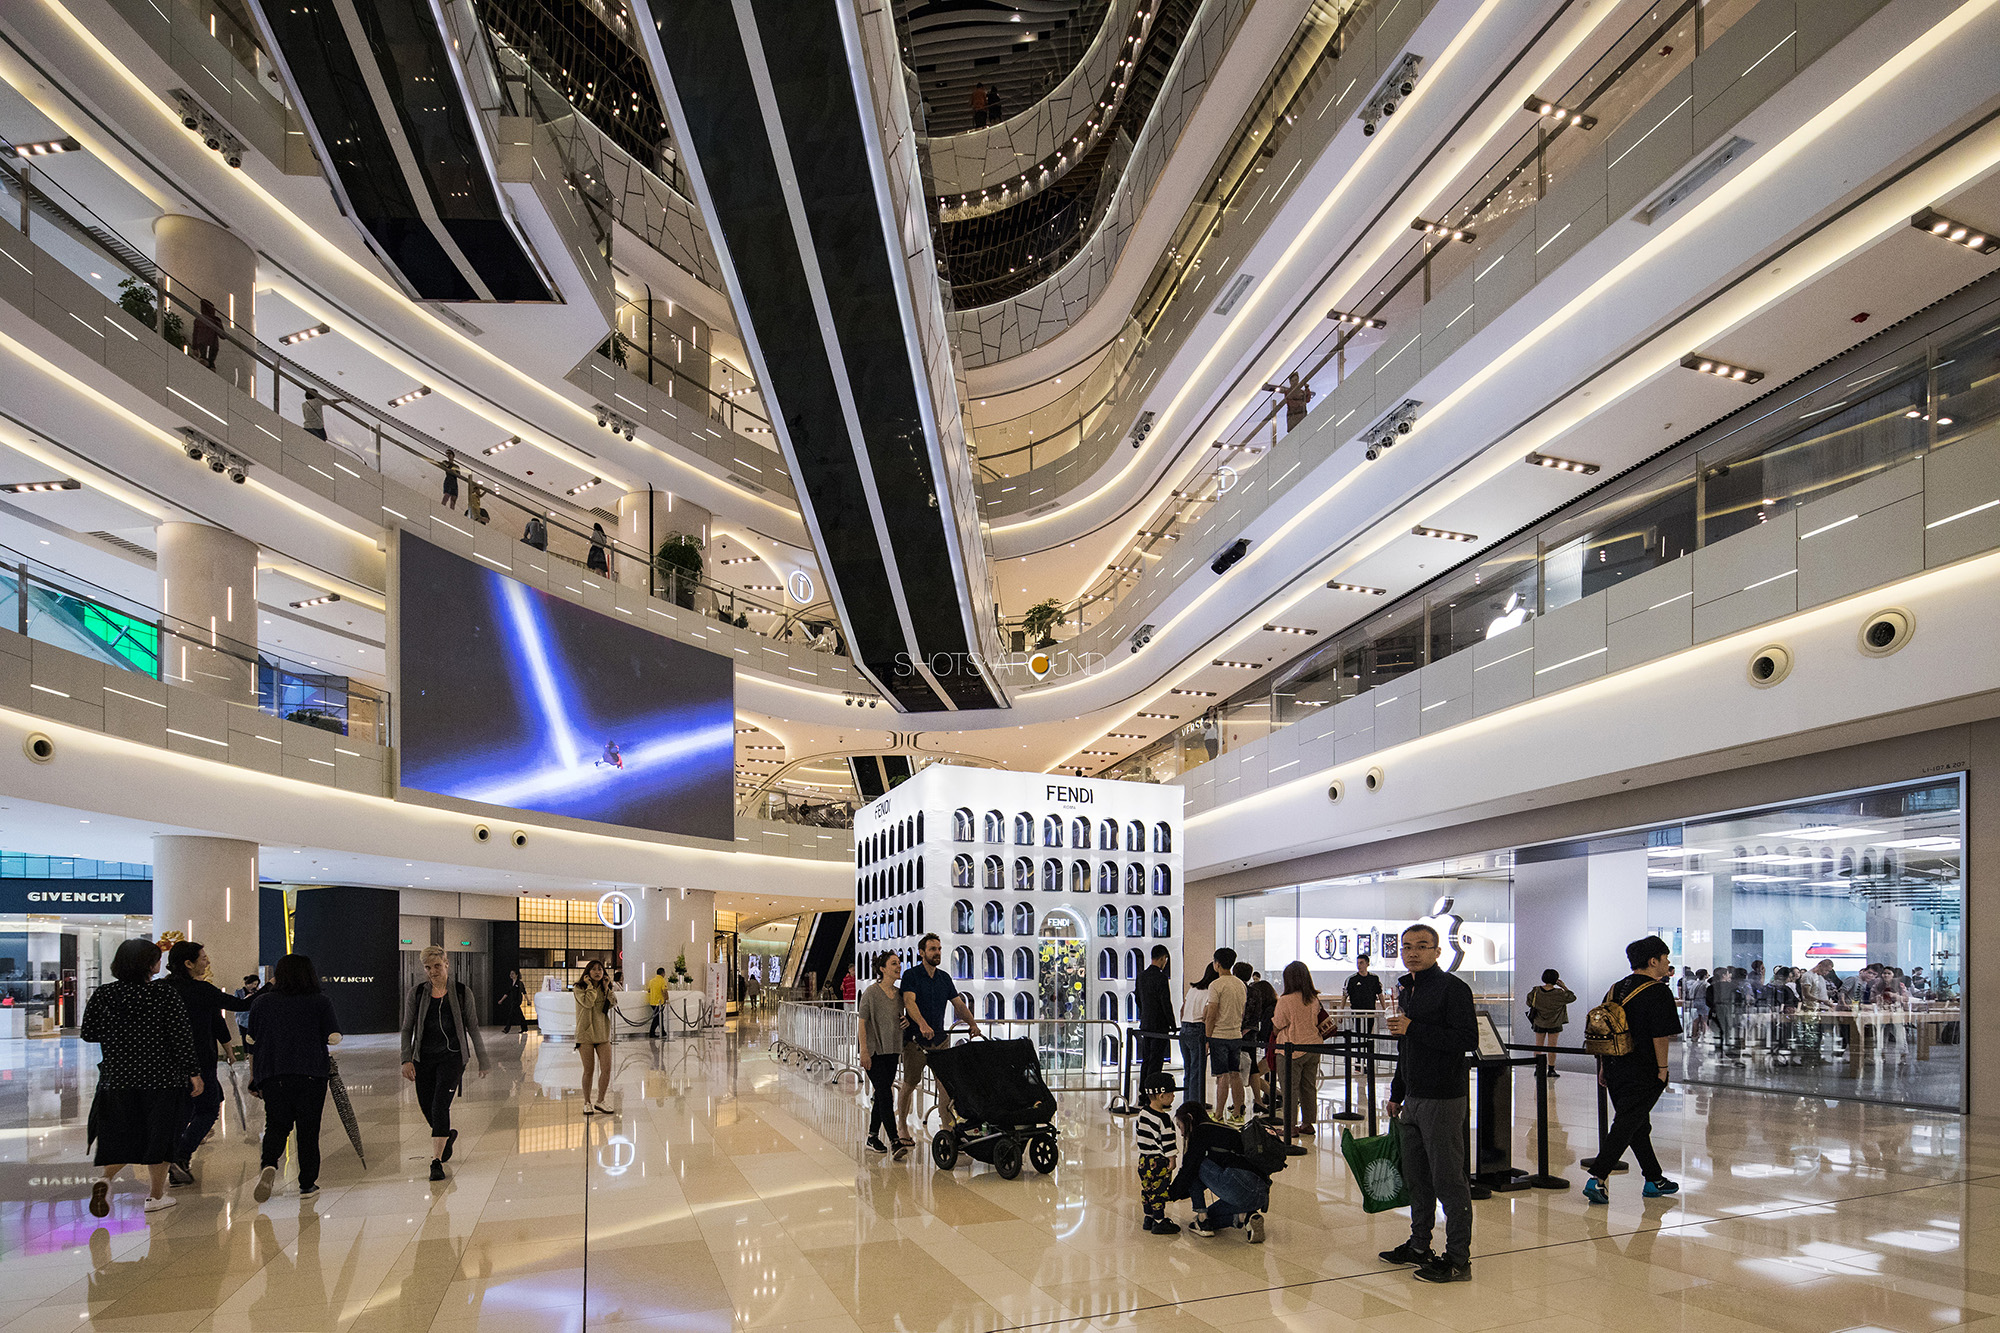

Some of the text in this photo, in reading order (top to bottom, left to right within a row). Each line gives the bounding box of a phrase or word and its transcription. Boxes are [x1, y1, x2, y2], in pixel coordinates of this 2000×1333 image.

[1046, 785, 1093, 804] FENDI
[874, 798, 892, 819] FENDI
[27, 891, 125, 902] GIVENCHY
[1047, 917, 1070, 927] FENDI
